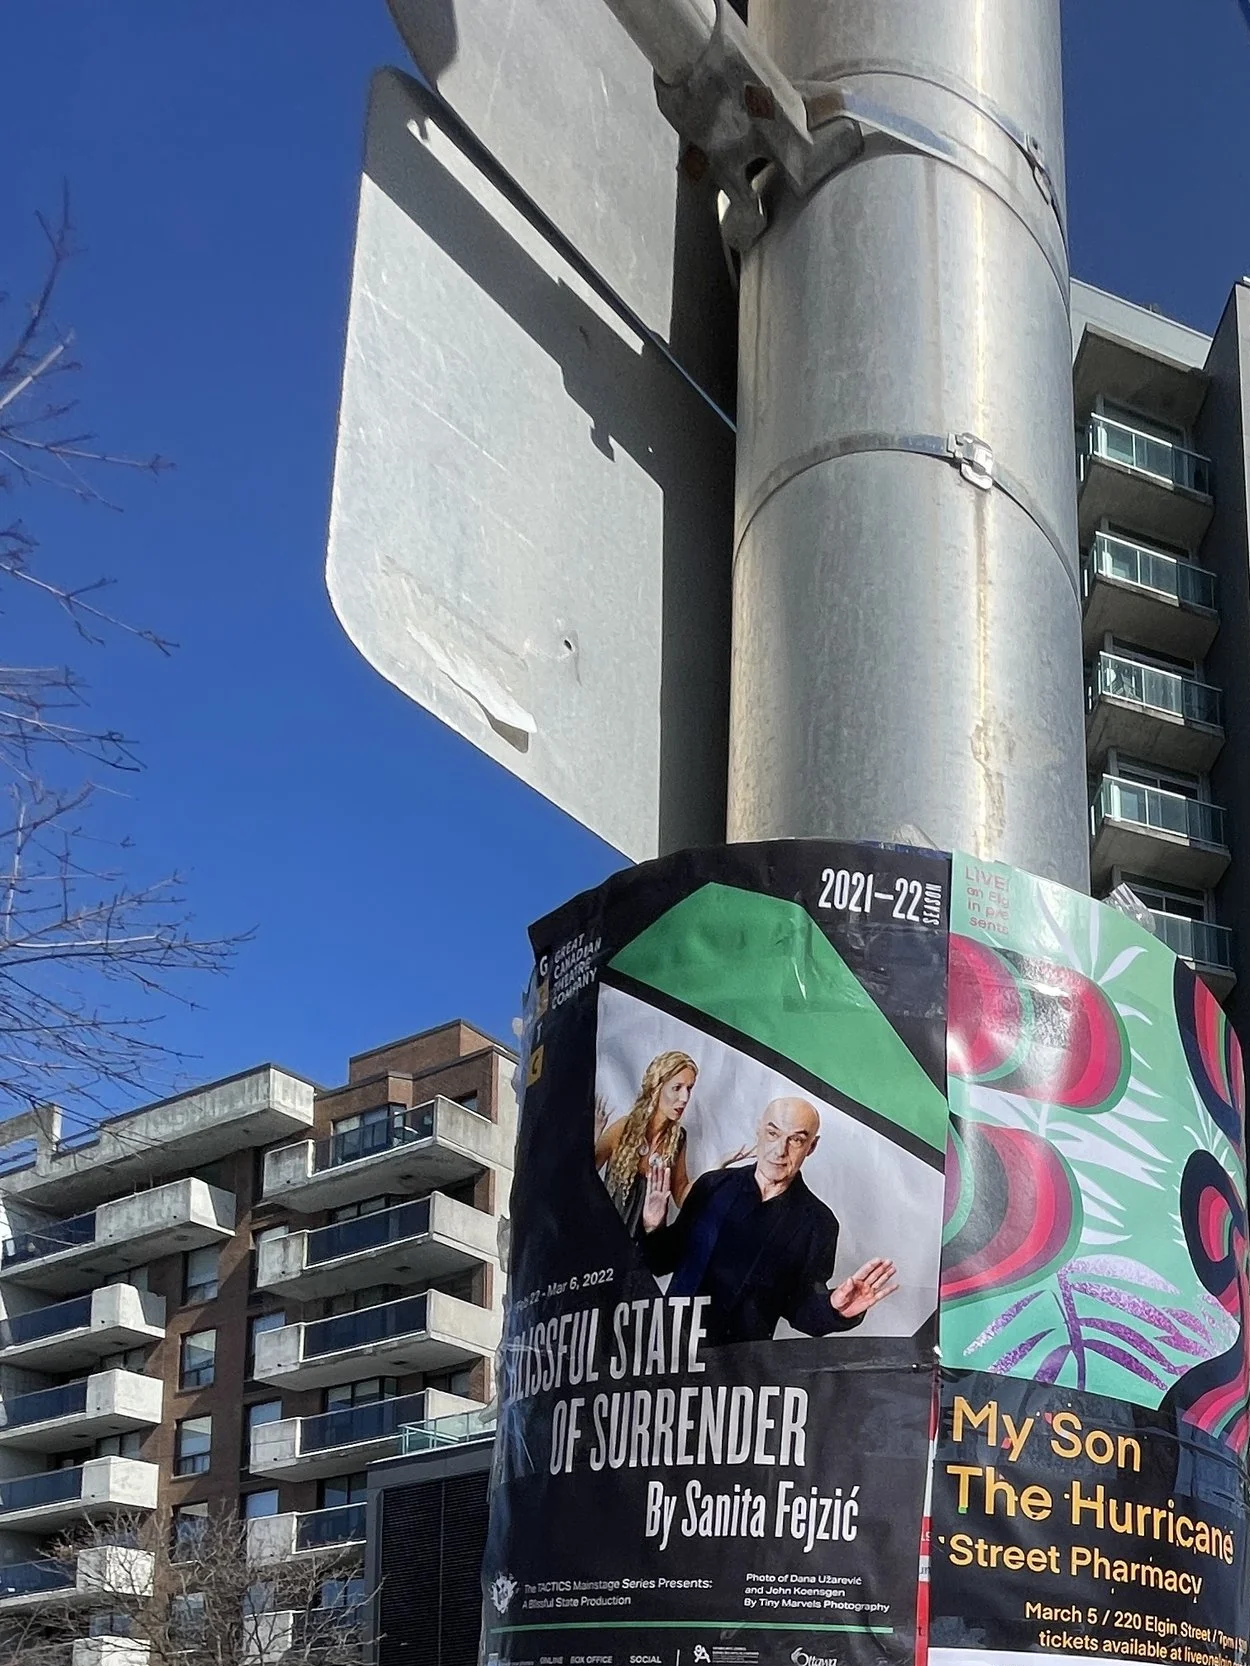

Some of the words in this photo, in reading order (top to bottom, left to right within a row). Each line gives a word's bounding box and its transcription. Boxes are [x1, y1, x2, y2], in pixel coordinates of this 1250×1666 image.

[922, 883, 942, 925] SEASON
[554, 933, 586, 963] GREAT
[554, 937, 602, 980] CANADIAN
[551, 966, 598, 1010] COMPANY
[553, 957, 592, 993] THEATRE
[547, 1281, 569, 1298] Mar
[569, 1275, 580, 1290] 6,
[583, 1267, 615, 1288] 2022
[609, 1296, 712, 1380] STATE
[549, 1398, 586, 1475] OF
[590, 1386, 809, 1472] SURRENDER
[951, 1396, 1034, 1461] My
[1050, 1412, 1141, 1471] Son
[646, 1480, 677, 1551] By
[681, 1479, 765, 1538] Sanita
[775, 1480, 860, 1553] Fejzić
[947, 1465, 1052, 1520] The
[1070, 1480, 1235, 1565] Hurricane
[746, 1573, 775, 1584] Photo
[777, 1573, 789, 1583] of
[790, 1574, 816, 1584] Dana
[949, 1534, 1060, 1574] Street
[1071, 1547, 1203, 1596] Pharmacy
[537, 1581, 572, 1593] TACTICS
[573, 1579, 620, 1592] Mainstage
[621, 1578, 656, 1590] Series
[657, 1577, 713, 1589] Presents:
[555, 1597, 579, 1608] State
[580, 1595, 632, 1607] Production
[744, 1585, 764, 1595] and
[765, 1586, 792, 1596] John
[744, 1597, 758, 1609] By
[758, 1597, 781, 1611] Tiny
[781, 1599, 822, 1610] Marvels
[823, 1600, 890, 1614] Photography
[1025, 1602, 1082, 1625] March
[1086, 1608, 1098, 1625] 5
[1101, 1609, 1110, 1627] /
[1114, 1610, 1142, 1630] 220
[1145, 1616, 1178, 1637] Elgin
[1180, 1621, 1211, 1642] Street
[586, 1656, 613, 1664] OFFICE
[629, 1655, 662, 1664] SOCIAL
[1038, 1629, 1099, 1651] tickets
[1102, 1637, 1167, 1659] available
[1170, 1646, 1182, 1661] at
